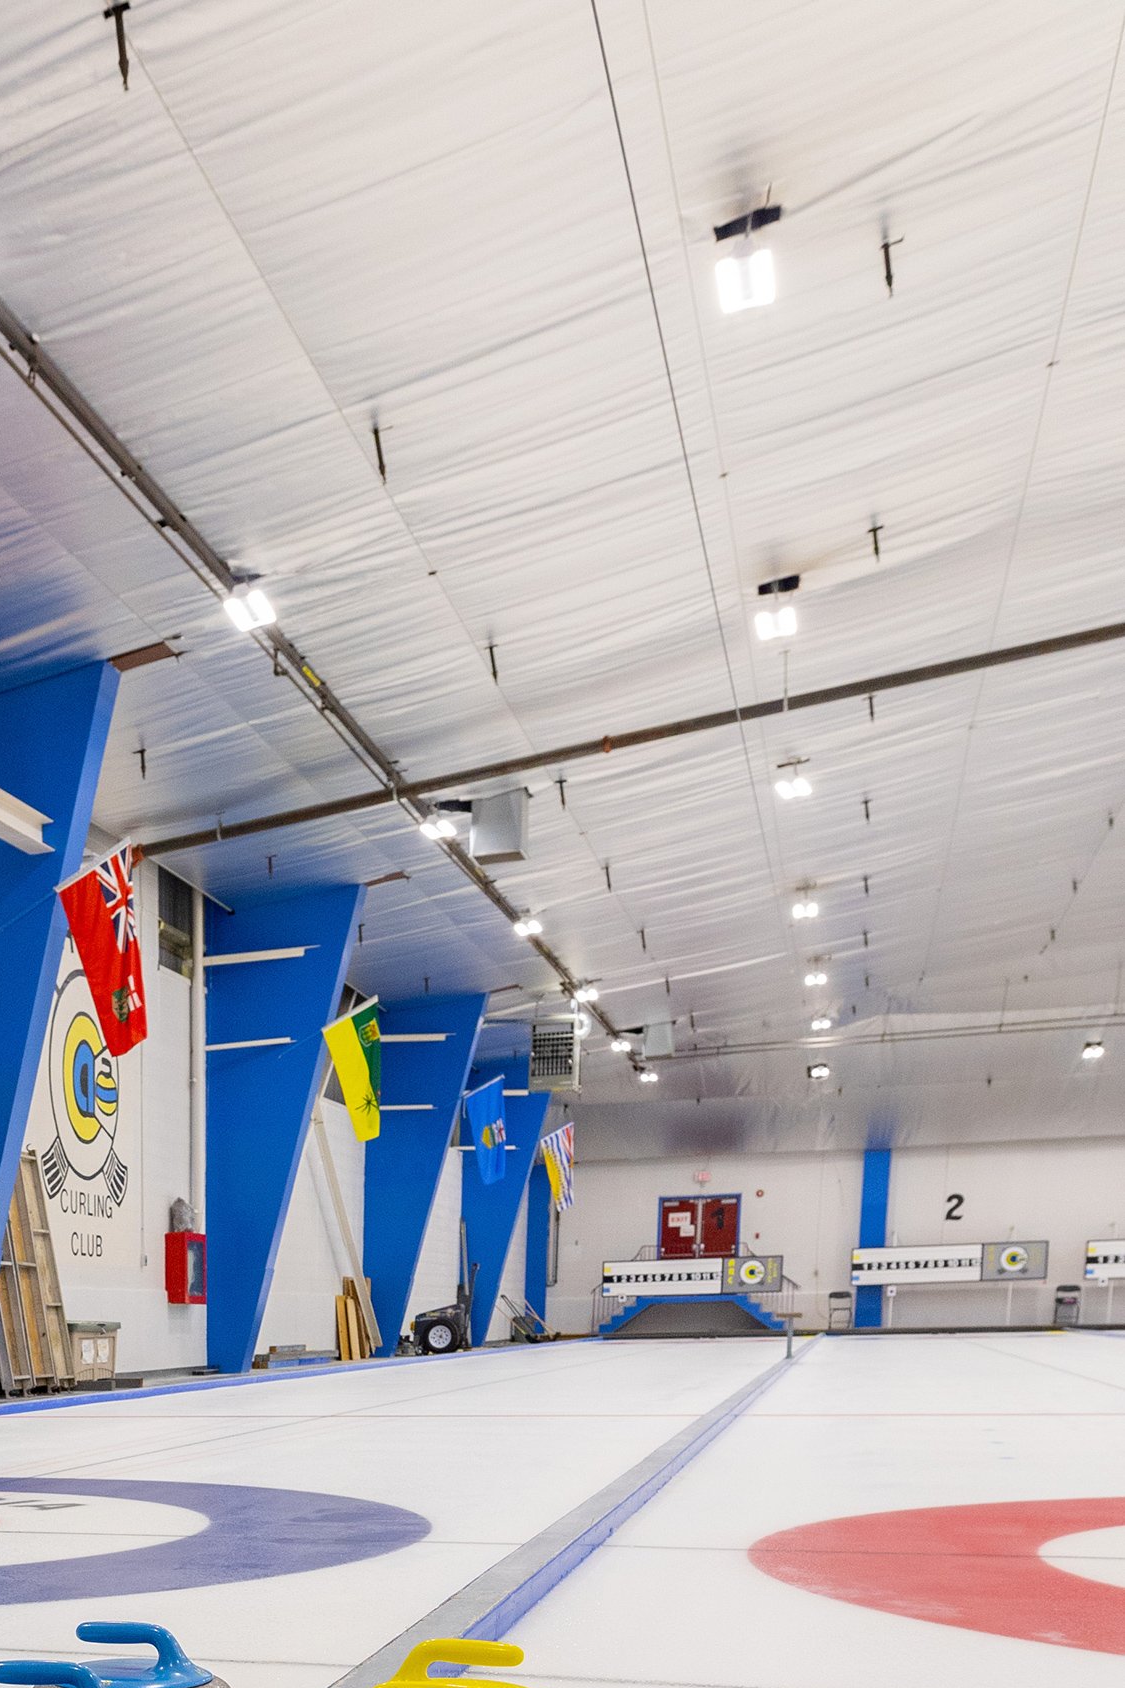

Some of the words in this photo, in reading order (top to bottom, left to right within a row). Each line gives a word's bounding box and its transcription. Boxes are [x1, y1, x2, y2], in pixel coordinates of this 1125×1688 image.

[60, 1188, 113, 1219] CURLING
[945, 1193, 965, 1221] 2
[712, 1207, 724, 1229] 1
[71, 1231, 103, 1257] CLUB
